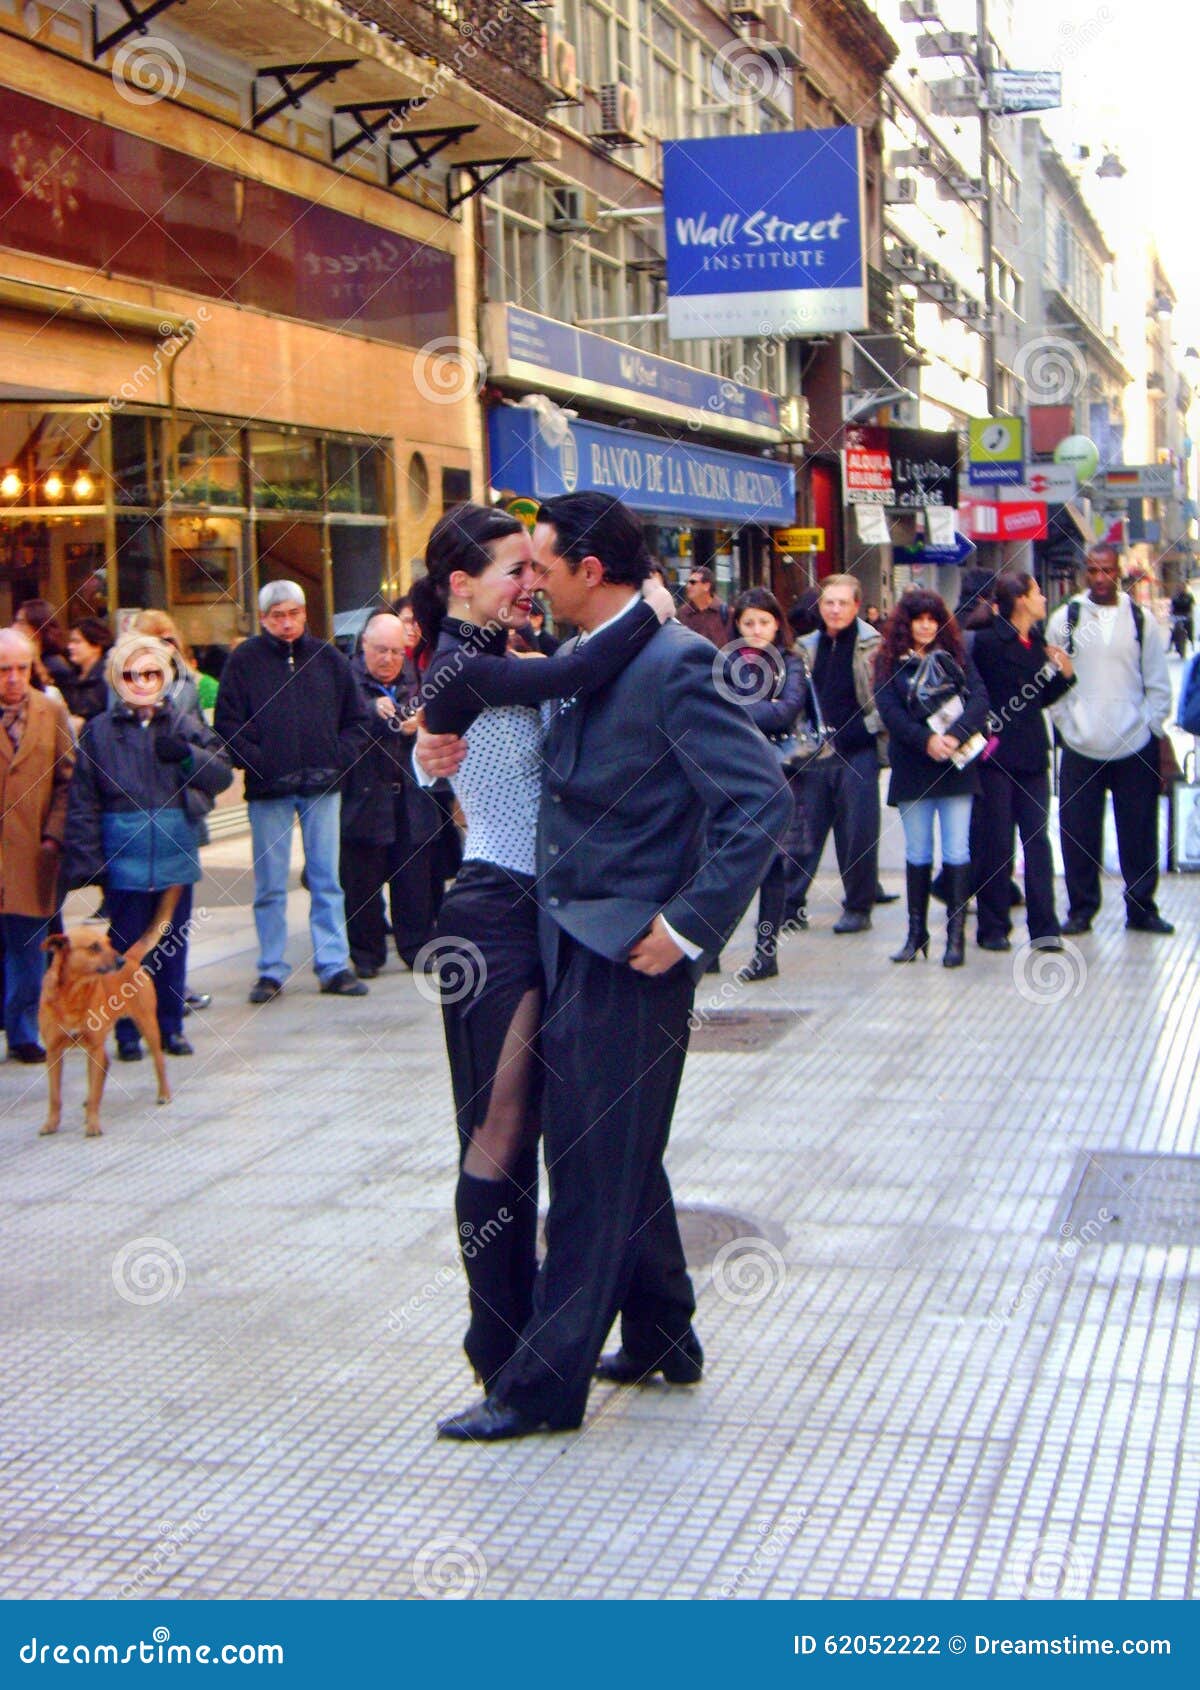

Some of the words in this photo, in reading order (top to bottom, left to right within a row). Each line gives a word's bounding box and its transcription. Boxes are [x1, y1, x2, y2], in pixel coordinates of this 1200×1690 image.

[676, 212, 740, 247] Wall
[742, 209, 848, 246] Street
[703, 250, 826, 271] INSTITUTE
[590, 443, 642, 489] BANCO
[646, 453, 665, 493] DE
[668, 457, 685, 495] LA
